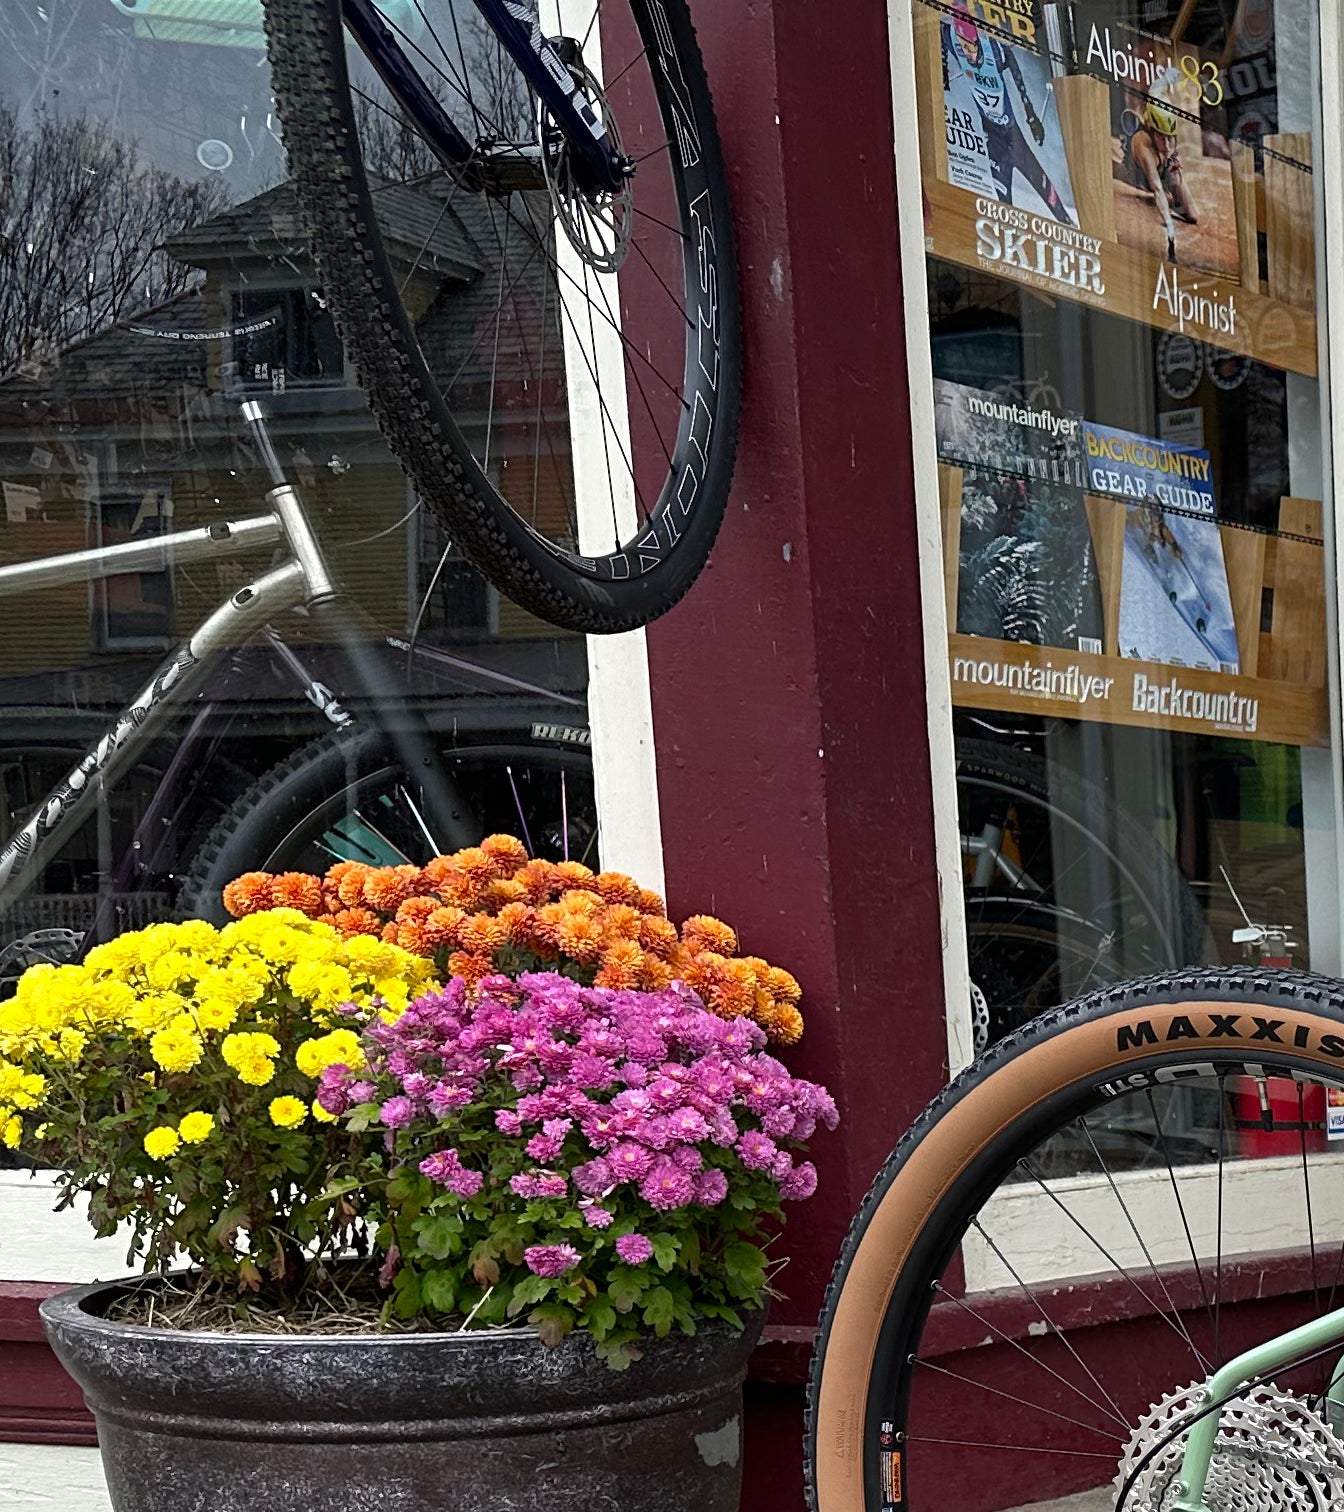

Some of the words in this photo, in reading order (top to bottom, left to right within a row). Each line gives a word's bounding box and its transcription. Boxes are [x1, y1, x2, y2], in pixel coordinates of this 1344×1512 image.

[1180, 55, 1224, 107] 83
[976, 198, 1029, 231] CROSS
[1031, 217, 1102, 255] COUNTRY
[975, 217, 1106, 296] SKIER
[1152, 261, 1237, 336] Alpinist
[968, 396, 1078, 437] mountainflyer
[1086, 431, 1210, 482] BACKCOUNTRY
[1092, 468, 1147, 499] GEAR
[1155, 483, 1214, 514] GUIDE
[953, 656, 1115, 703] mountainflyer
[1132, 671, 1258, 733] Backcountry
